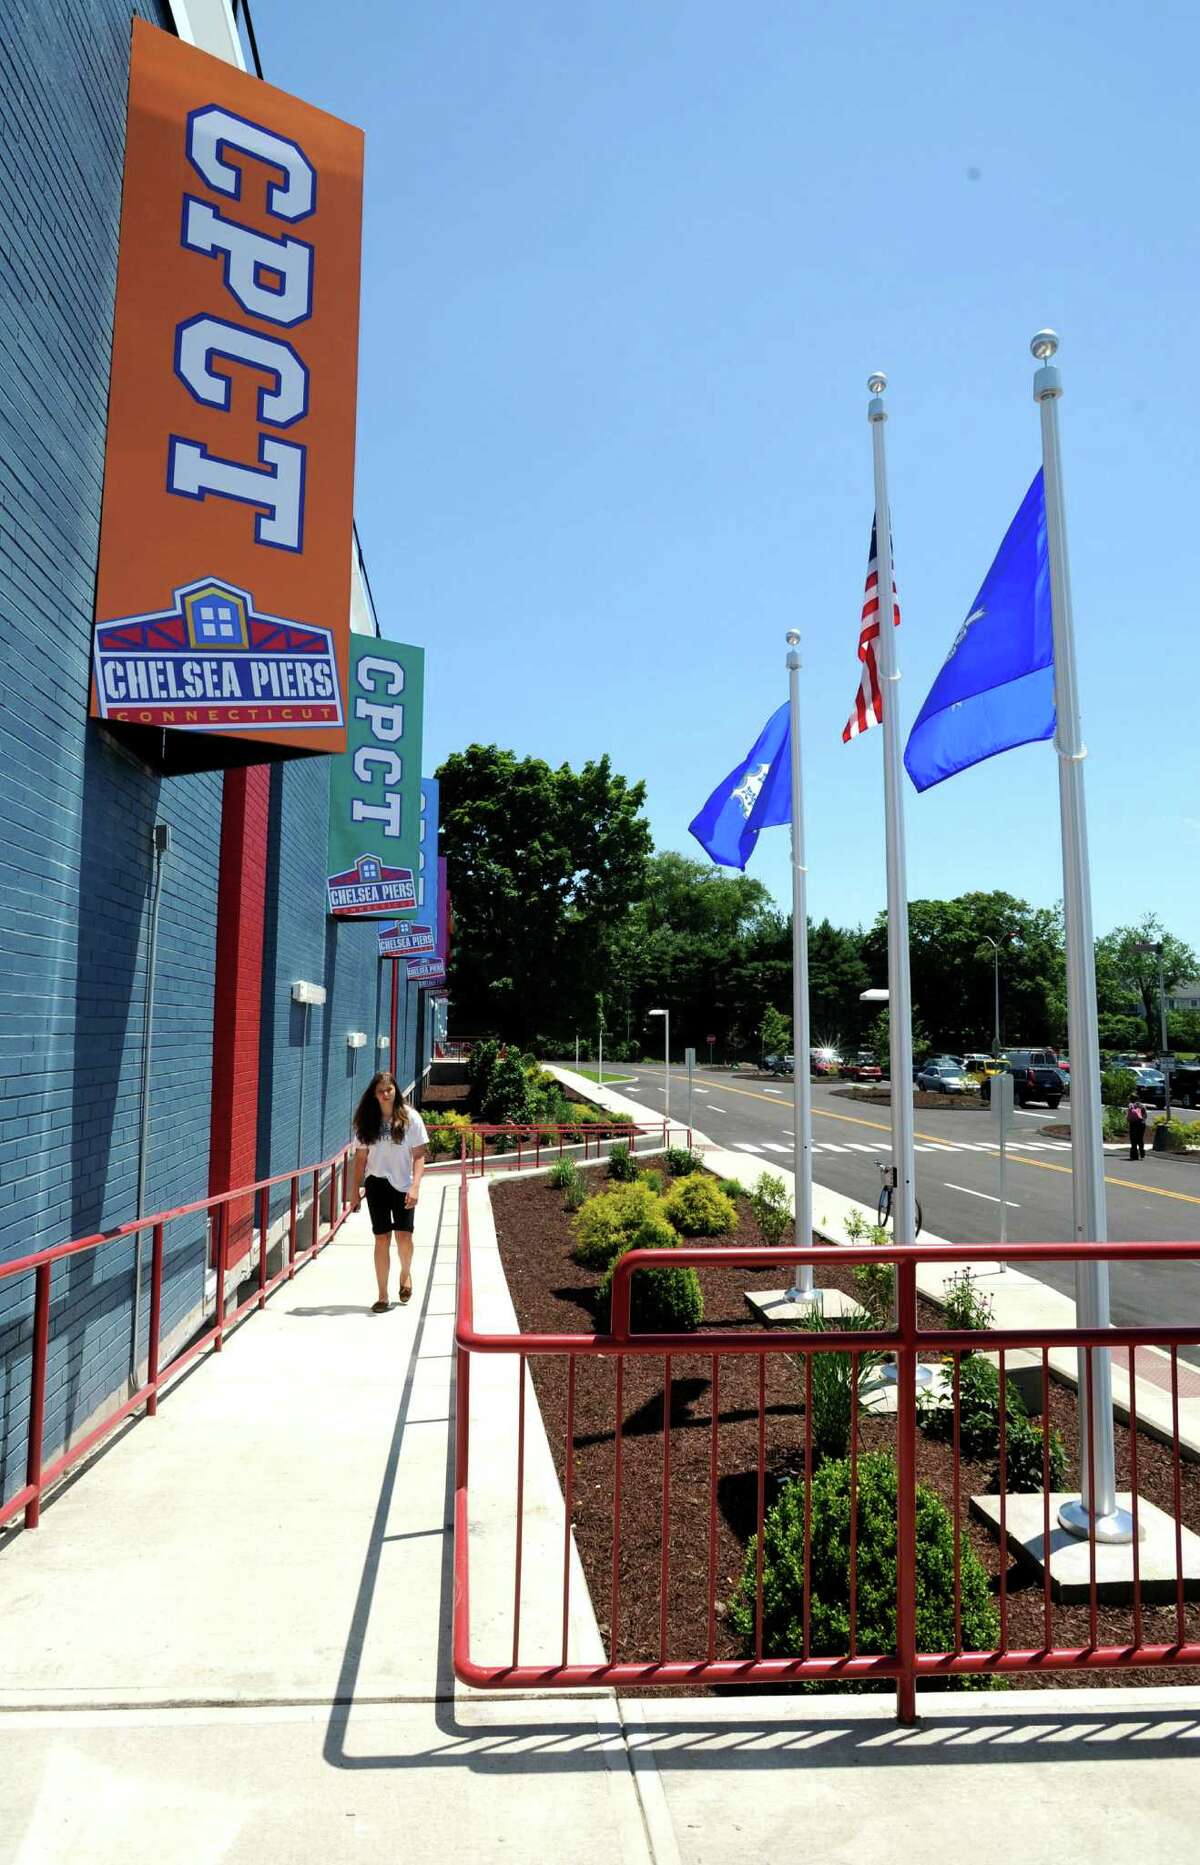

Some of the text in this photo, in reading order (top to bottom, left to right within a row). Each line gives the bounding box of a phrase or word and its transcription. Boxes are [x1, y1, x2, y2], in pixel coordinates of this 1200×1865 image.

[167, 103, 317, 554] CPCT
[103, 660, 334, 699] CHELSEA PIERS
[116, 708, 332, 723] CONNECTICUT
[352, 654, 405, 838] CPCT
[330, 882, 413, 905] CHELSEA PIERS
